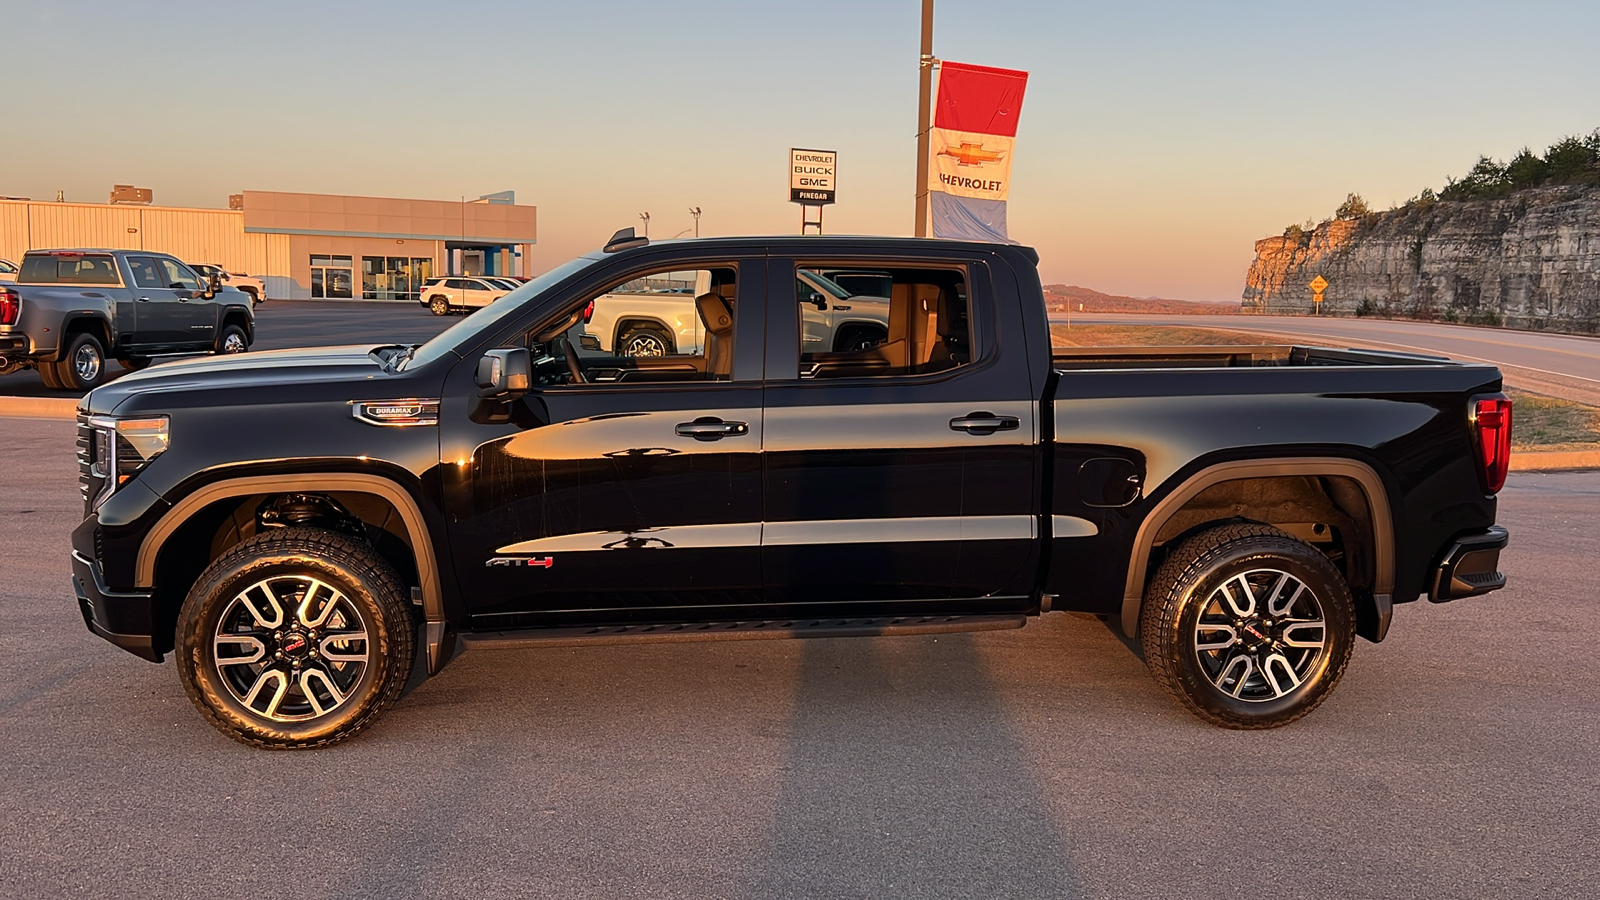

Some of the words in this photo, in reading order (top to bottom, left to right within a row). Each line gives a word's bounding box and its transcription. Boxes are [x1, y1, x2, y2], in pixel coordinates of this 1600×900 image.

[795, 154, 833, 163] CHEVROLET
[794, 166, 833, 175] BUICK
[799, 177, 828, 187] GMC
[799, 191, 828, 200] PINEGAR
[485, 556, 553, 569] AT4
